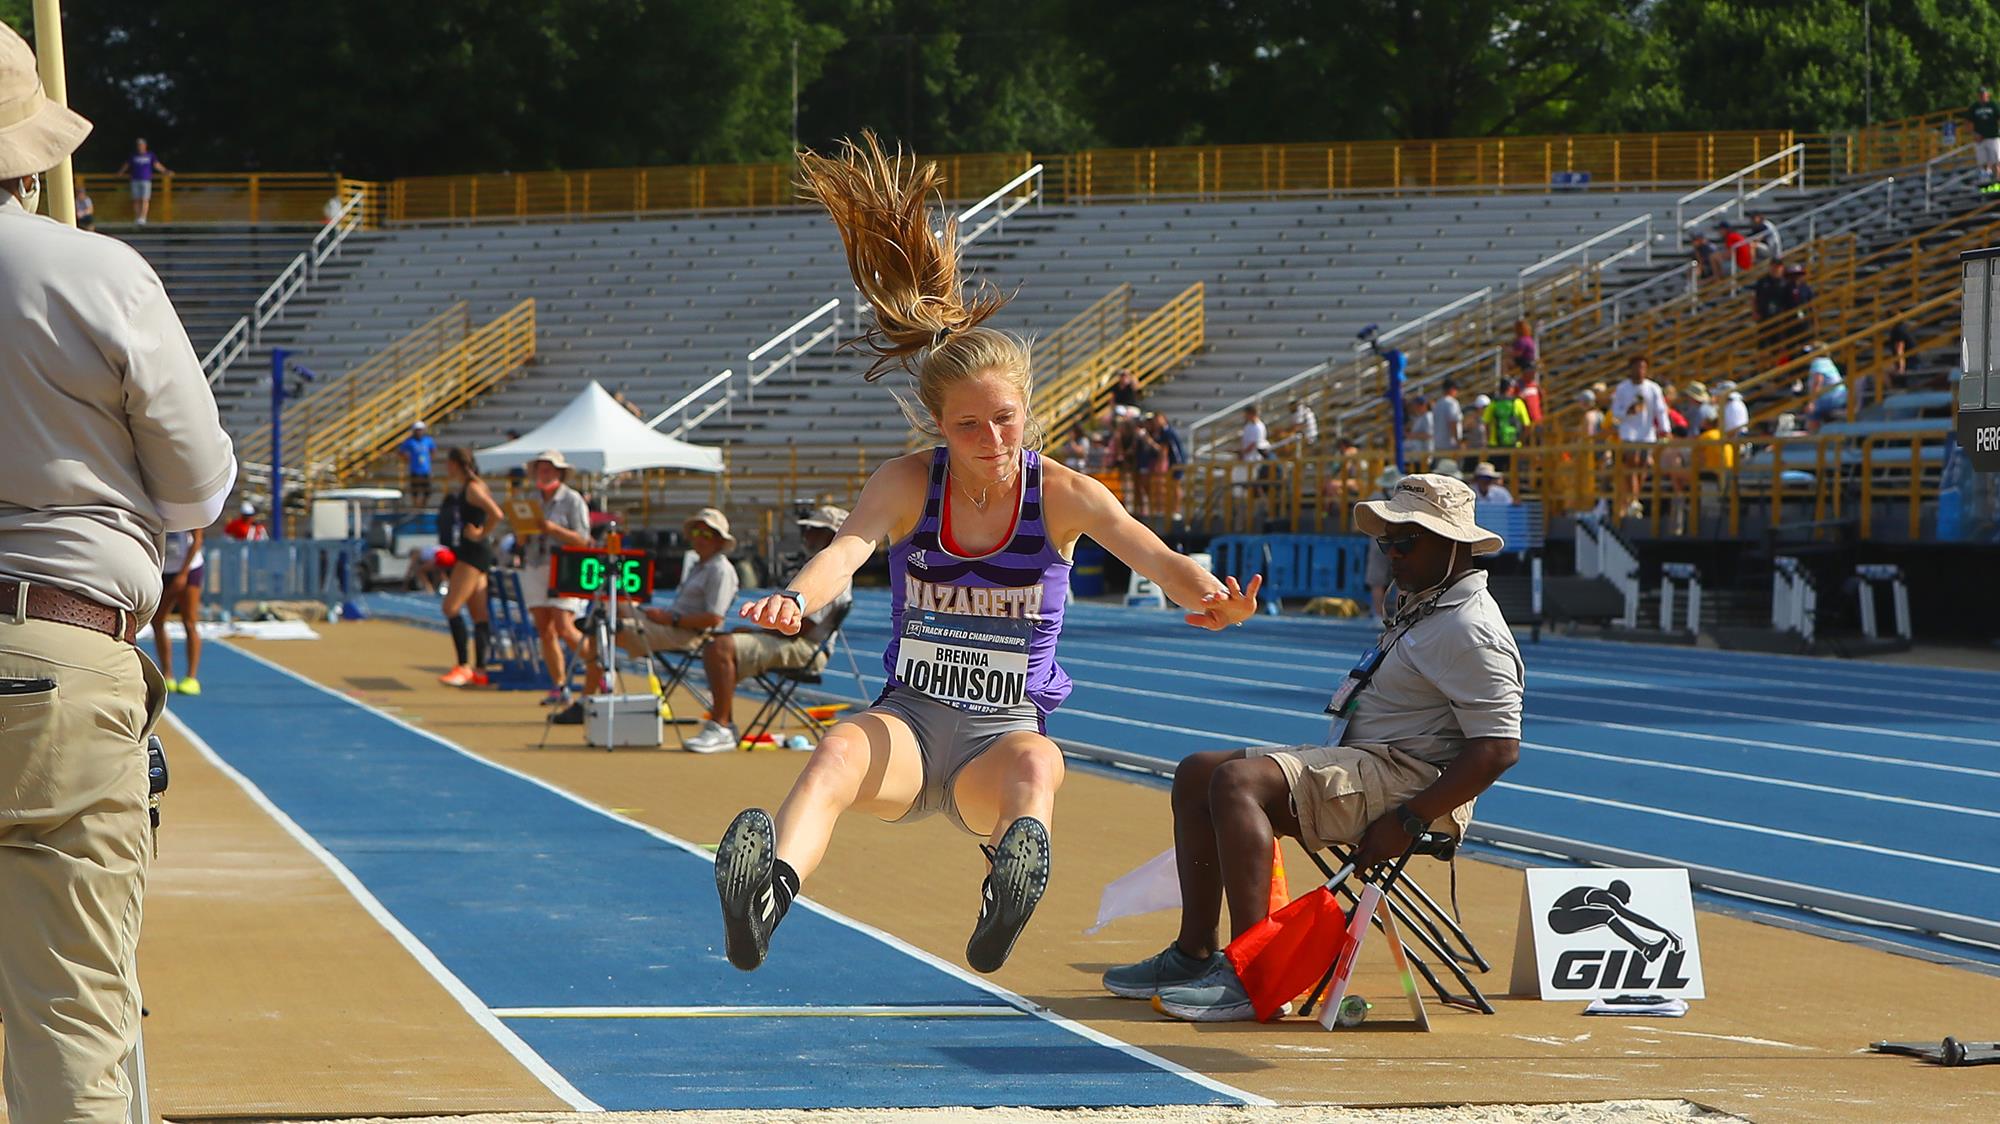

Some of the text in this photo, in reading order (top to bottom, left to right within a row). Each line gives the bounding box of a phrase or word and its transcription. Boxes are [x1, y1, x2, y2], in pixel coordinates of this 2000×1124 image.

[581, 557, 641, 593] 0:6
[904, 572, 1044, 618] NAZARETH
[921, 625, 944, 637] TRACK
[943, 628, 950, 637] &
[949, 629, 969, 640] FIELD
[968, 631, 1026, 647] CHAMPIONSHIPS
[935, 647, 990, 667] BRENNA
[897, 658, 1025, 706] JOHNSON
[1551, 949, 1691, 990] GILL
